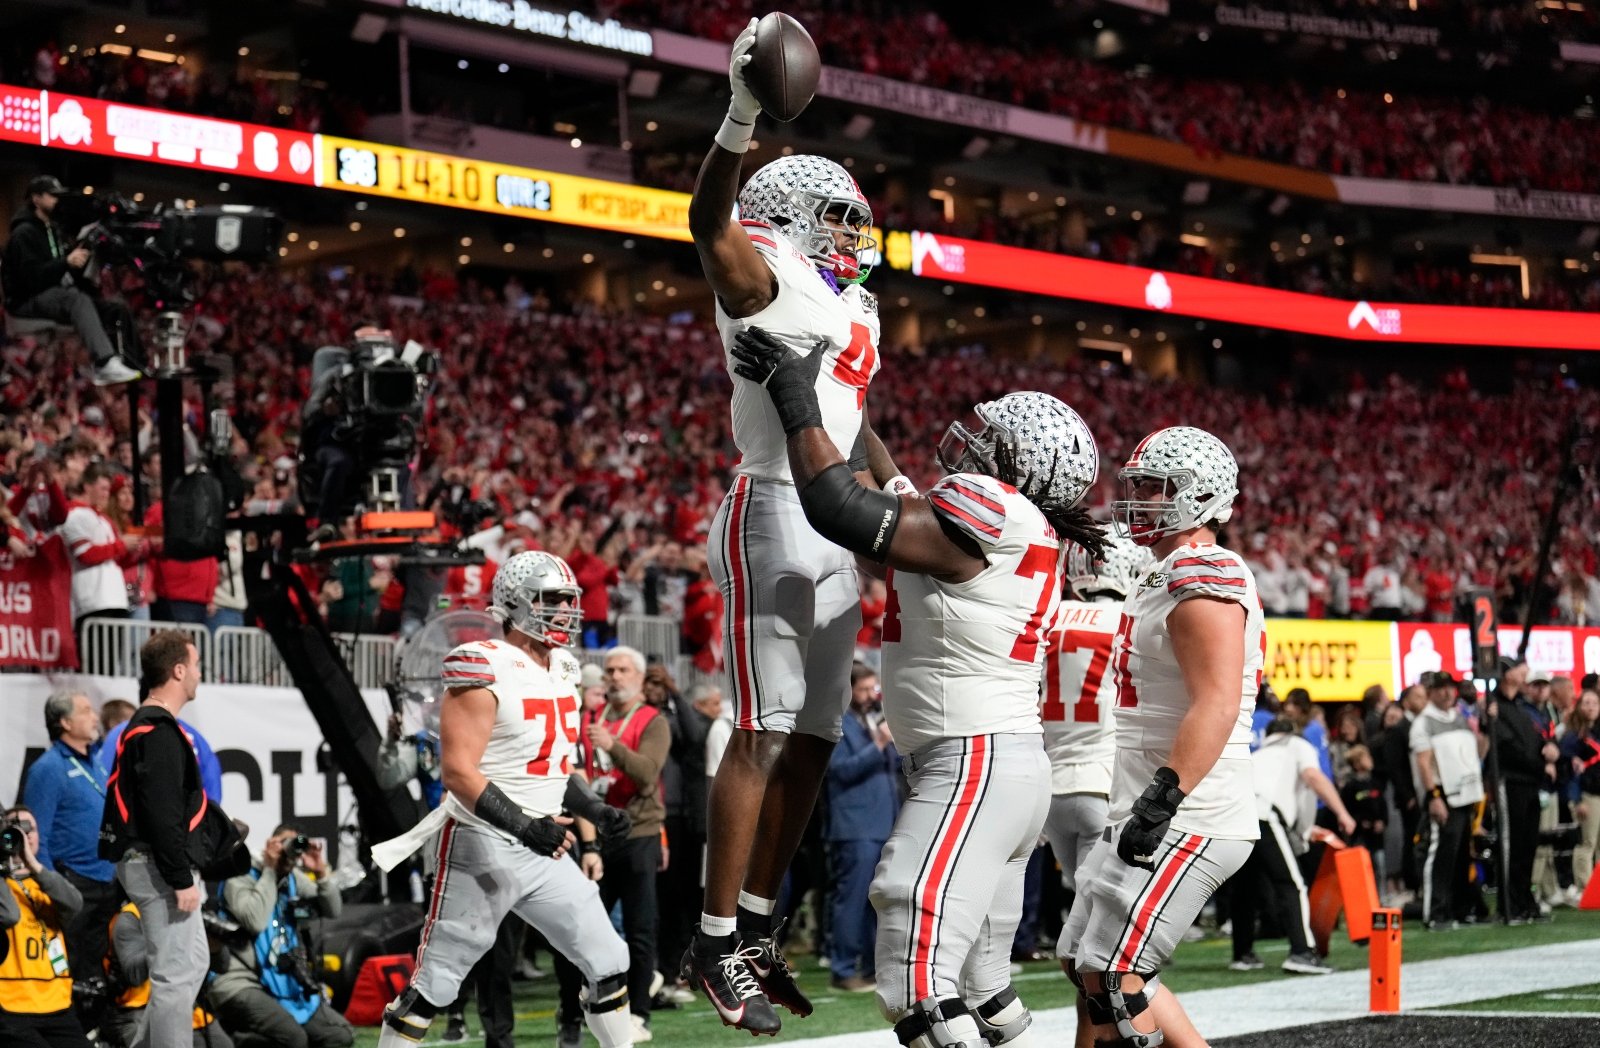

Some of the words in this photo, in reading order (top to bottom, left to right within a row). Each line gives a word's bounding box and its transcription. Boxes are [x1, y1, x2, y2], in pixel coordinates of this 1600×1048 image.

[568, 10, 652, 56] Stadium
[1216, 6, 1288, 31] COLLEGE
[1290, 13, 1369, 40] FOOTBALL
[1370, 19, 1439, 46] PLAYOFF
[397, 154, 480, 201] 14:10
[832, 322, 876, 411] 4
[1062, 609, 1103, 626] TATE
[1474, 597, 1495, 646] 2
[1043, 630, 1114, 722] 17
[1264, 642, 1357, 678] AYOFF
[522, 695, 578, 776] 75
